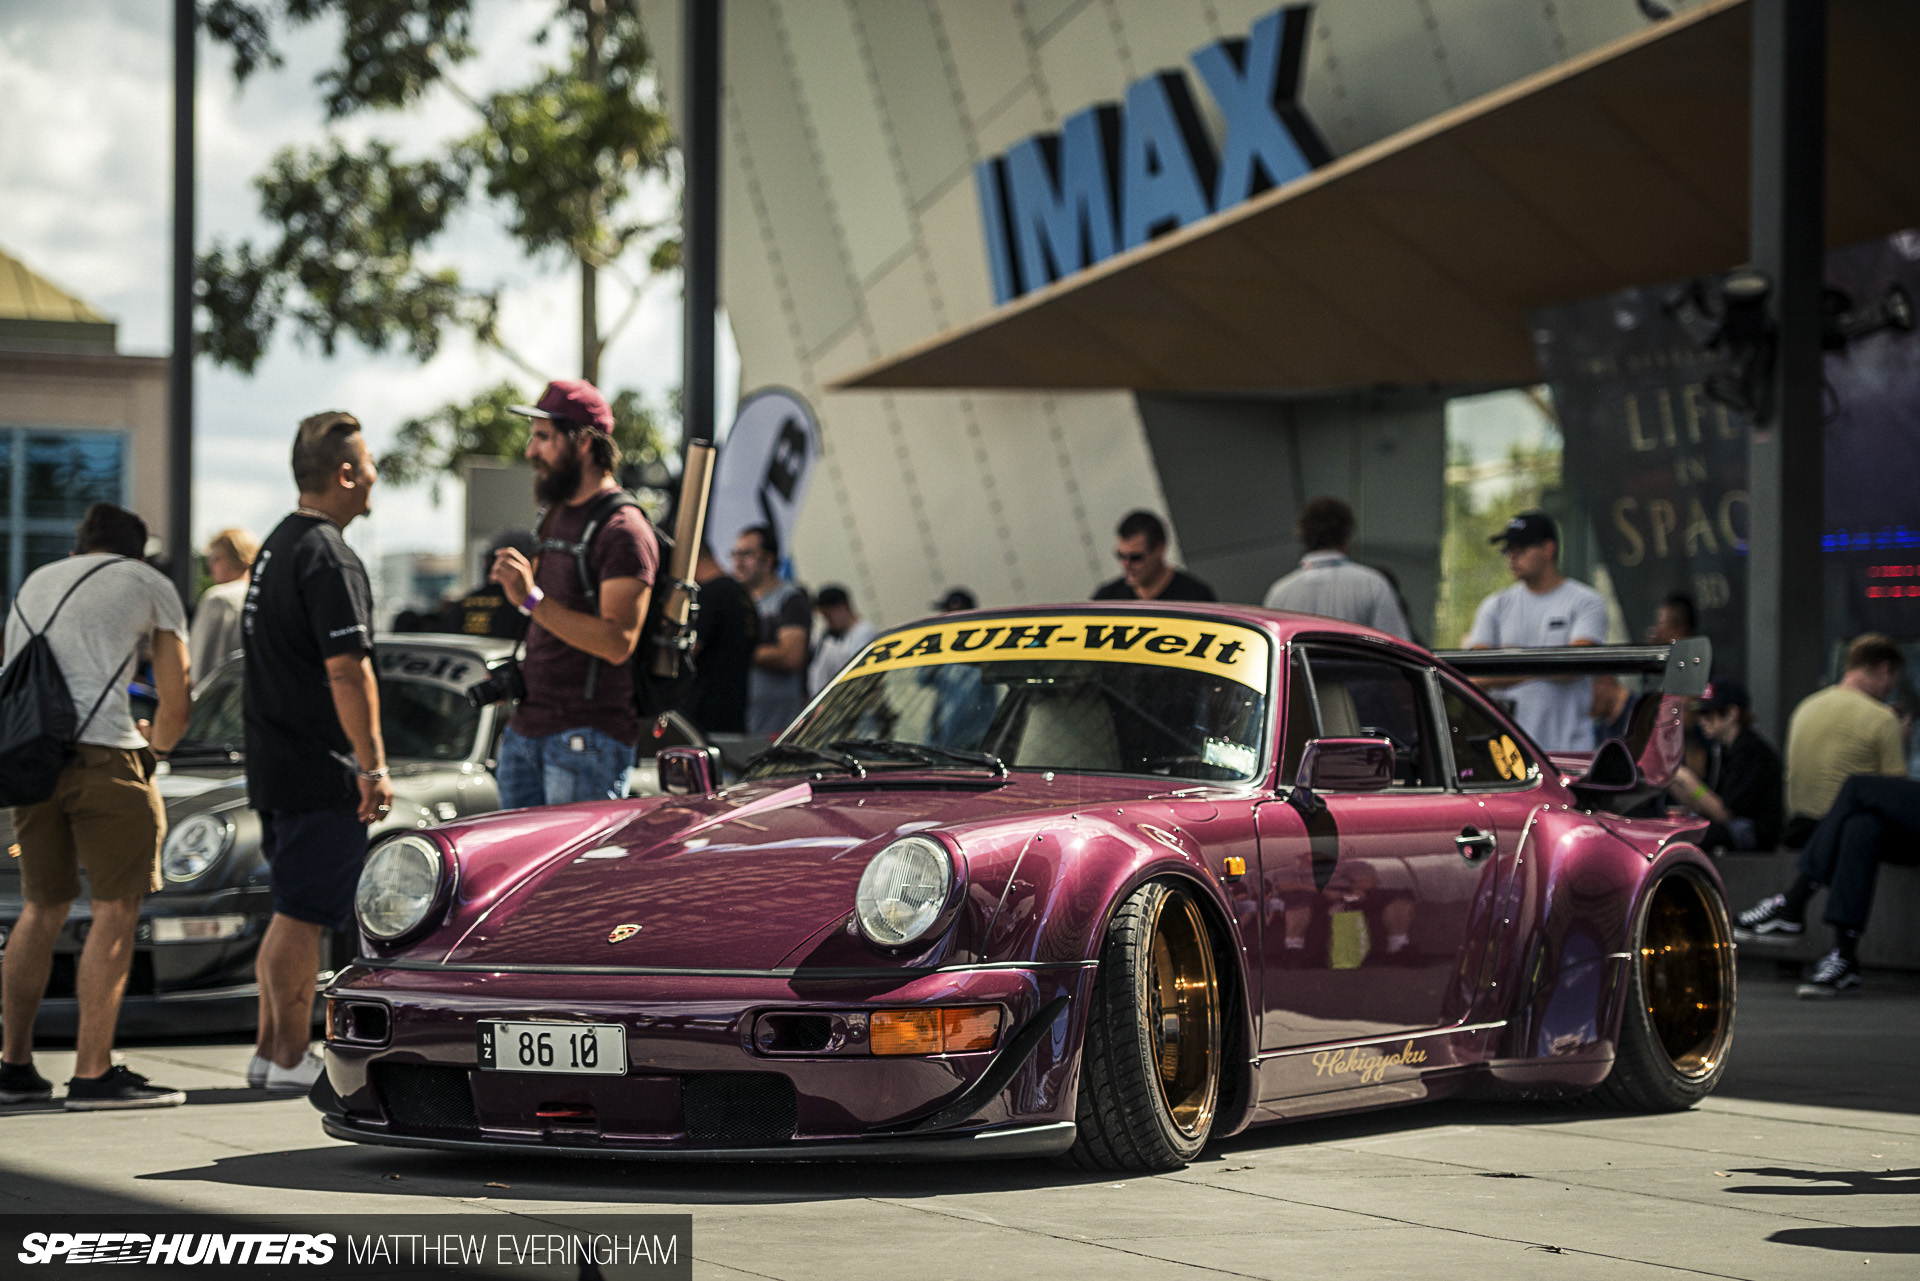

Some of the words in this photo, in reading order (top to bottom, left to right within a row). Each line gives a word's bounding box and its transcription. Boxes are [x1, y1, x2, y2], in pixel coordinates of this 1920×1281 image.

[974, 3, 1326, 307] IMAX
[1611, 488, 1749, 568] SPAC
[857, 624, 1246, 667] RAUH-Welt
[518, 1031, 554, 1067] 86
[569, 1033, 598, 1068] 10
[1311, 1039, 1428, 1084] Hekigyoku
